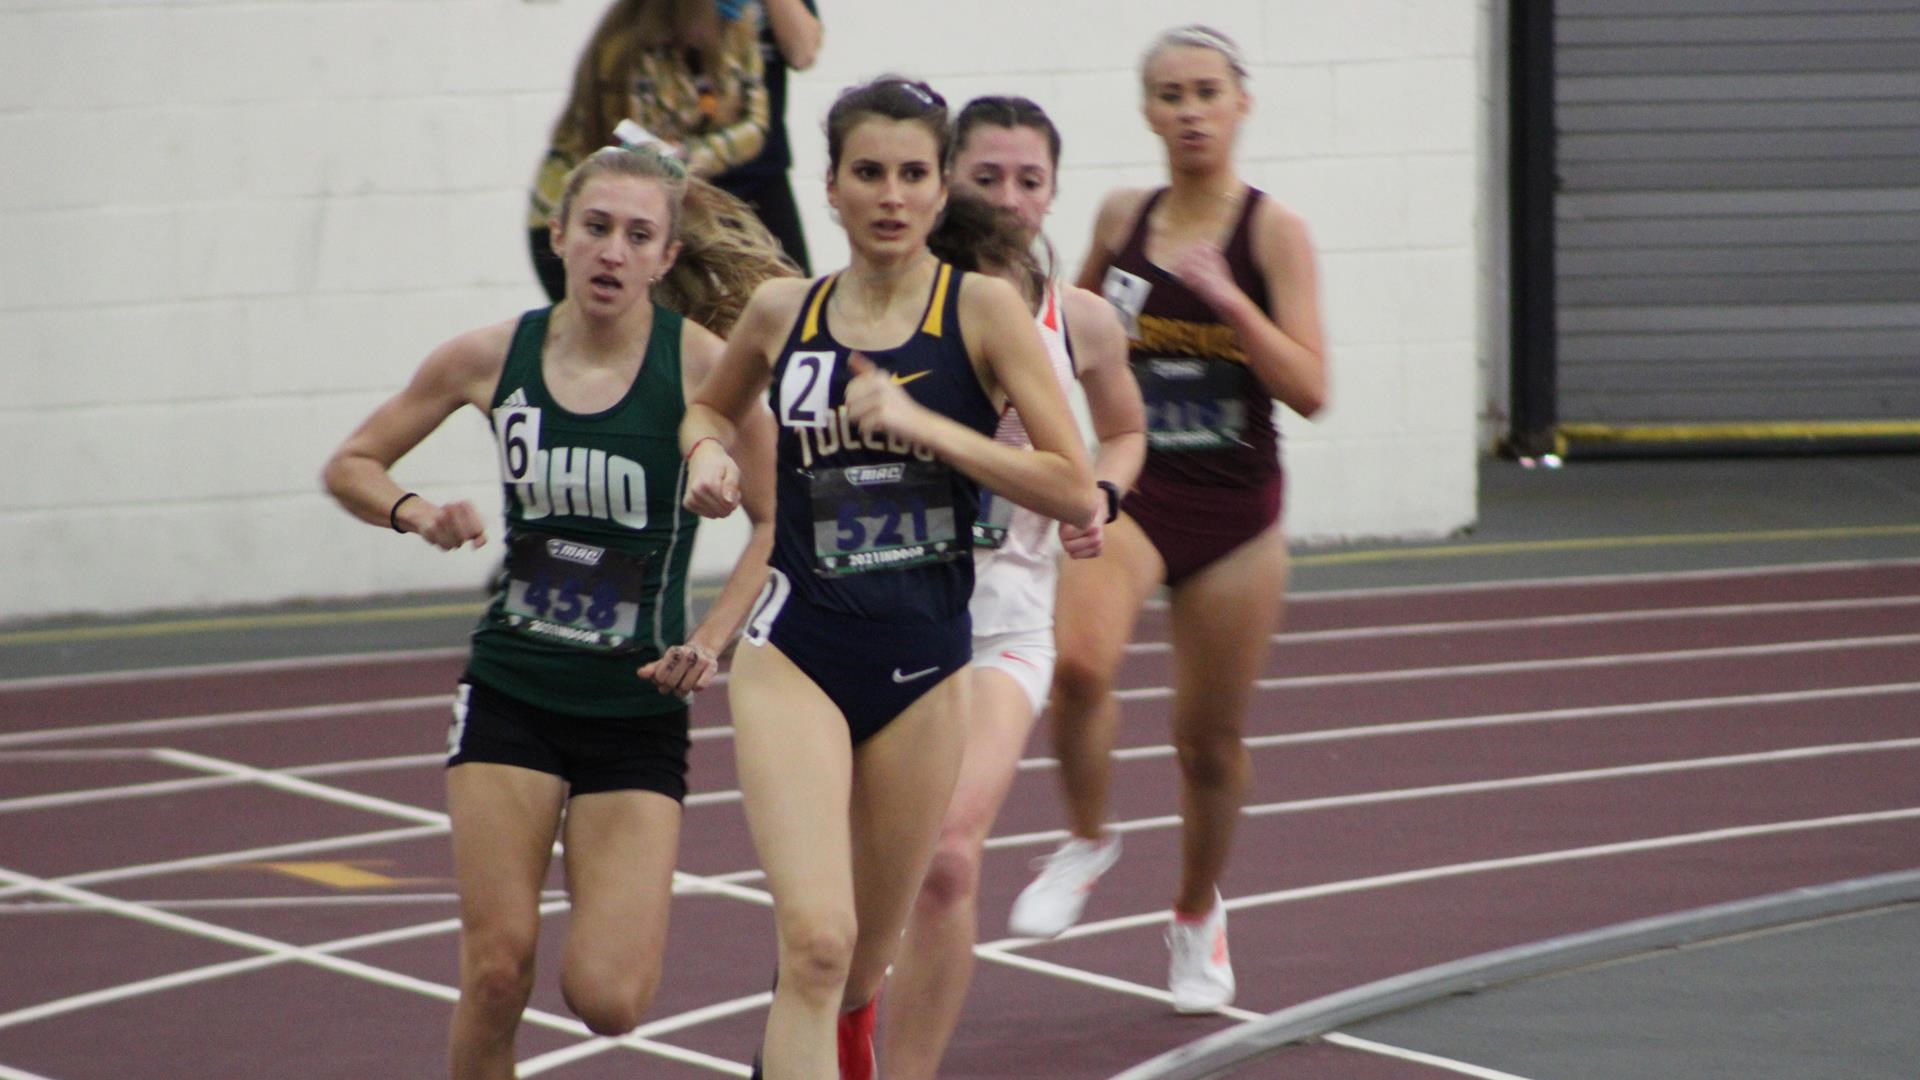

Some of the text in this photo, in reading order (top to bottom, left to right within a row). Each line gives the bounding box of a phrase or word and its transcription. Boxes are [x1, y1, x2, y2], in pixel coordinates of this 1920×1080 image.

[788, 356, 820, 421] 2
[505, 412, 528, 479] 6
[516, 447, 648, 529] OHIO
[837, 496, 928, 550] 521
[525, 573, 619, 629] 458
